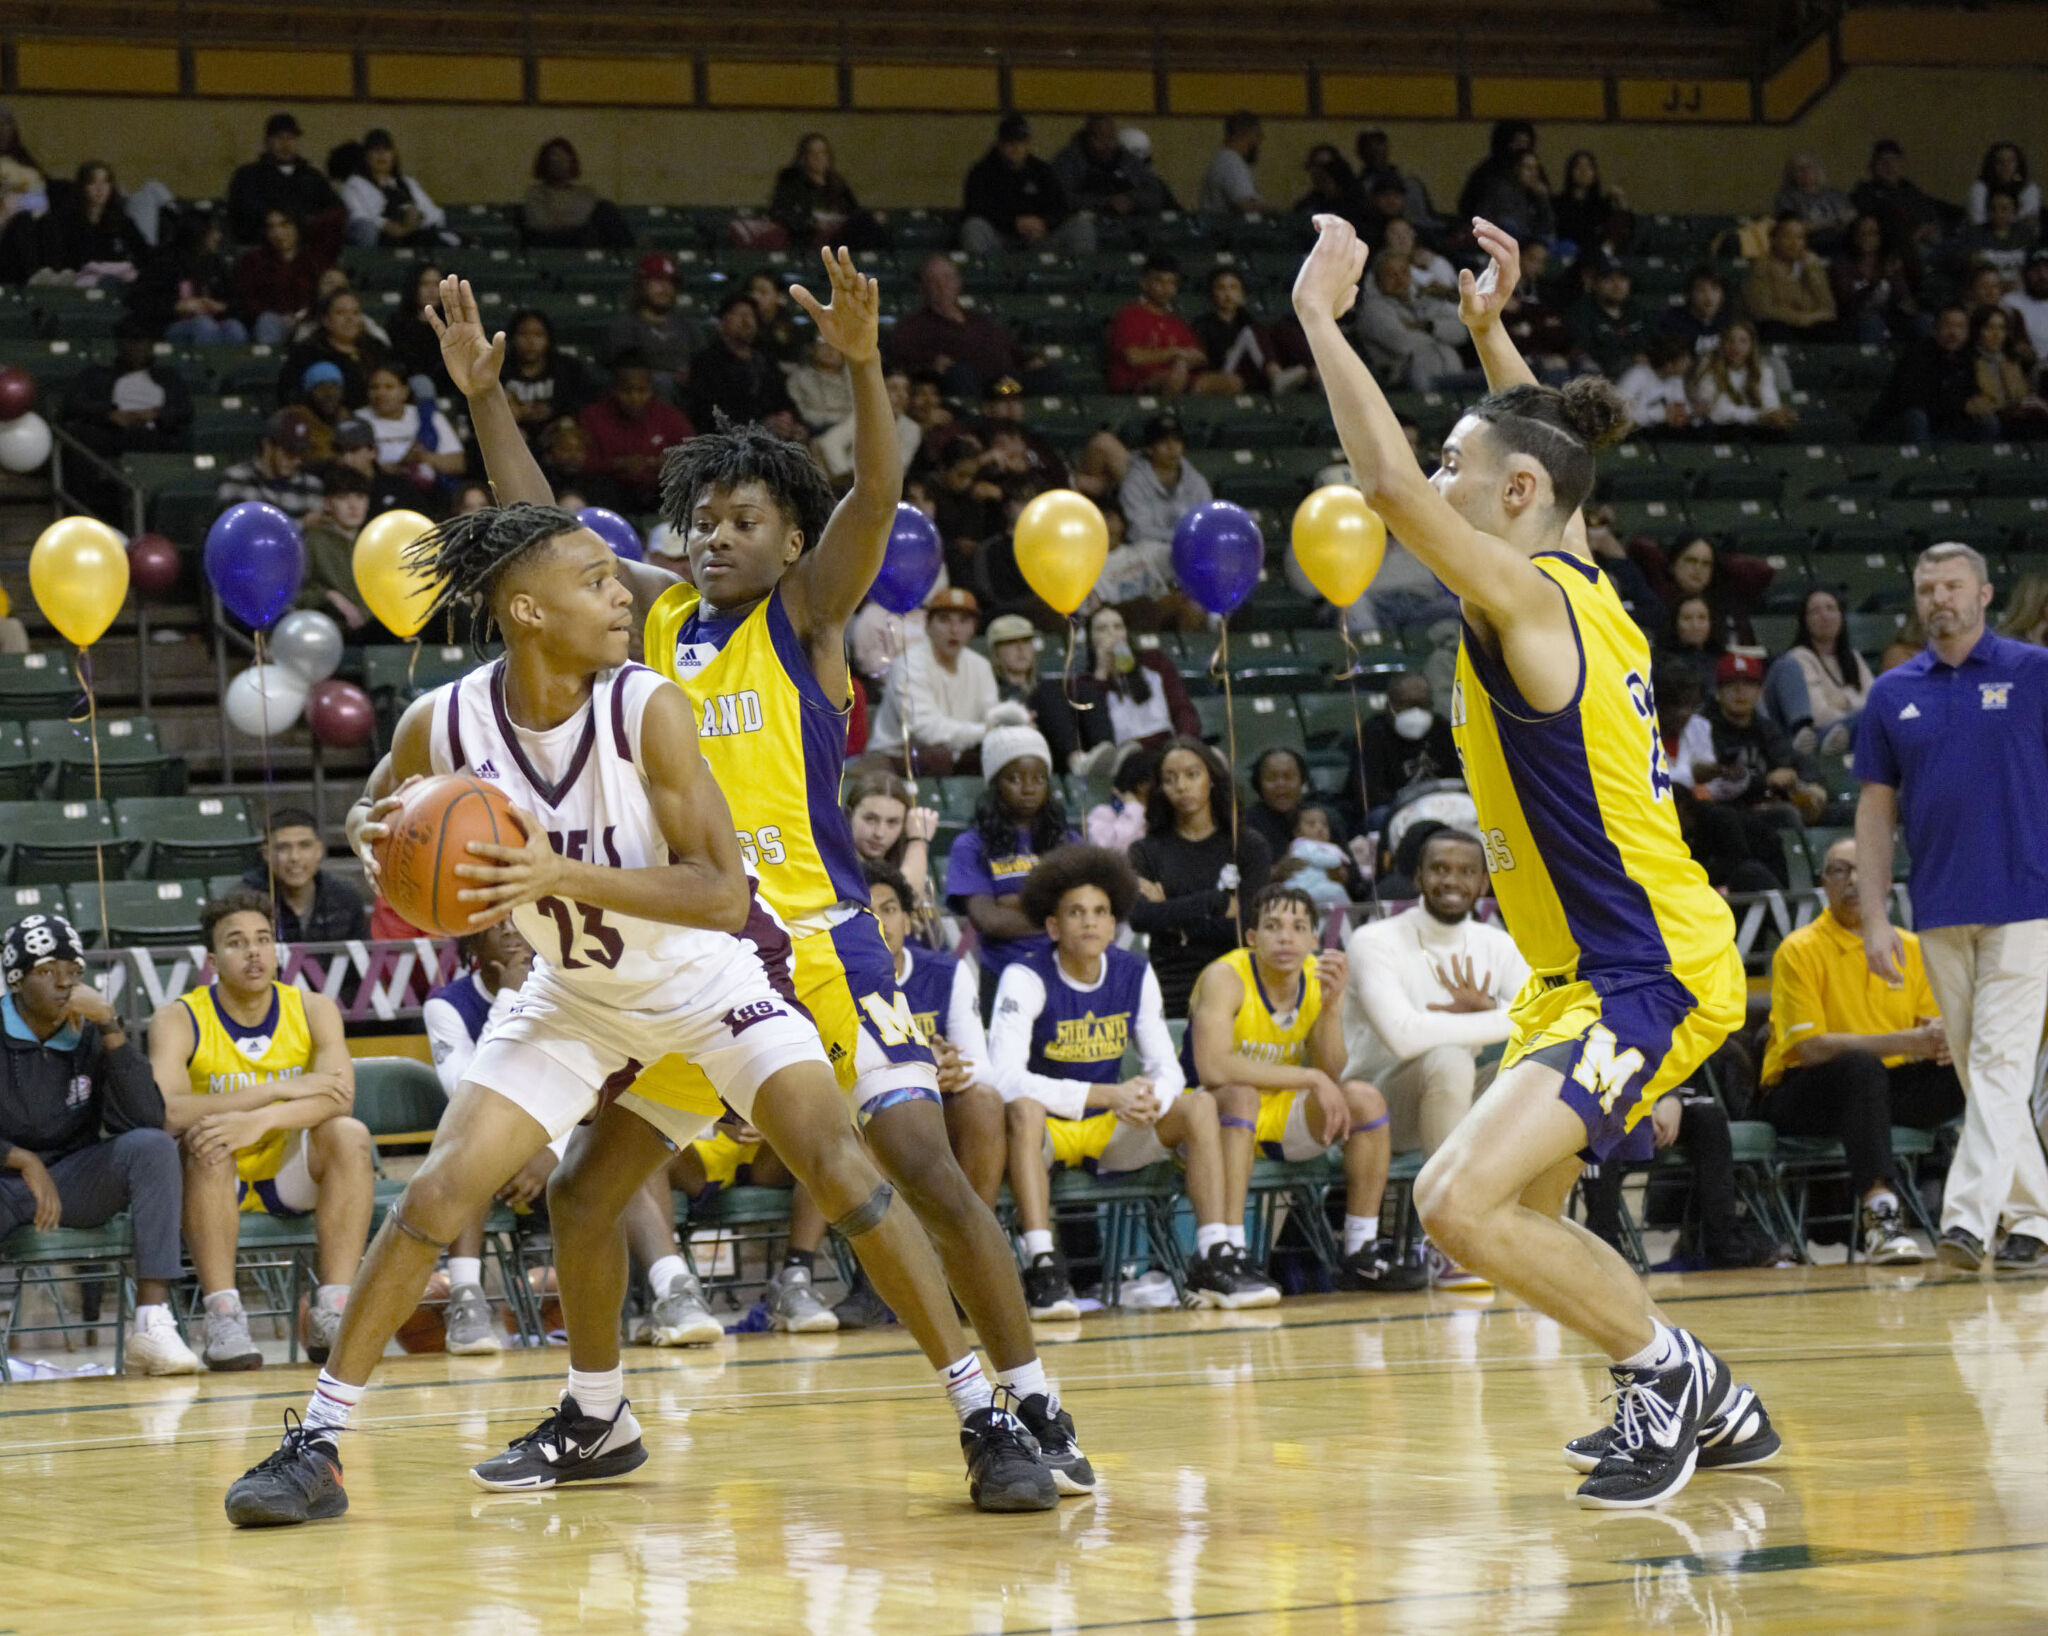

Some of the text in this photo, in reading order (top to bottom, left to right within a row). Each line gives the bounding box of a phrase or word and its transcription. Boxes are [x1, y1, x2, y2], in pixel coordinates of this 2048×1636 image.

[1664, 84, 1702, 112] JJ
[535, 894, 625, 970] 23
[1057, 1017, 1128, 1045] MIDLAND
